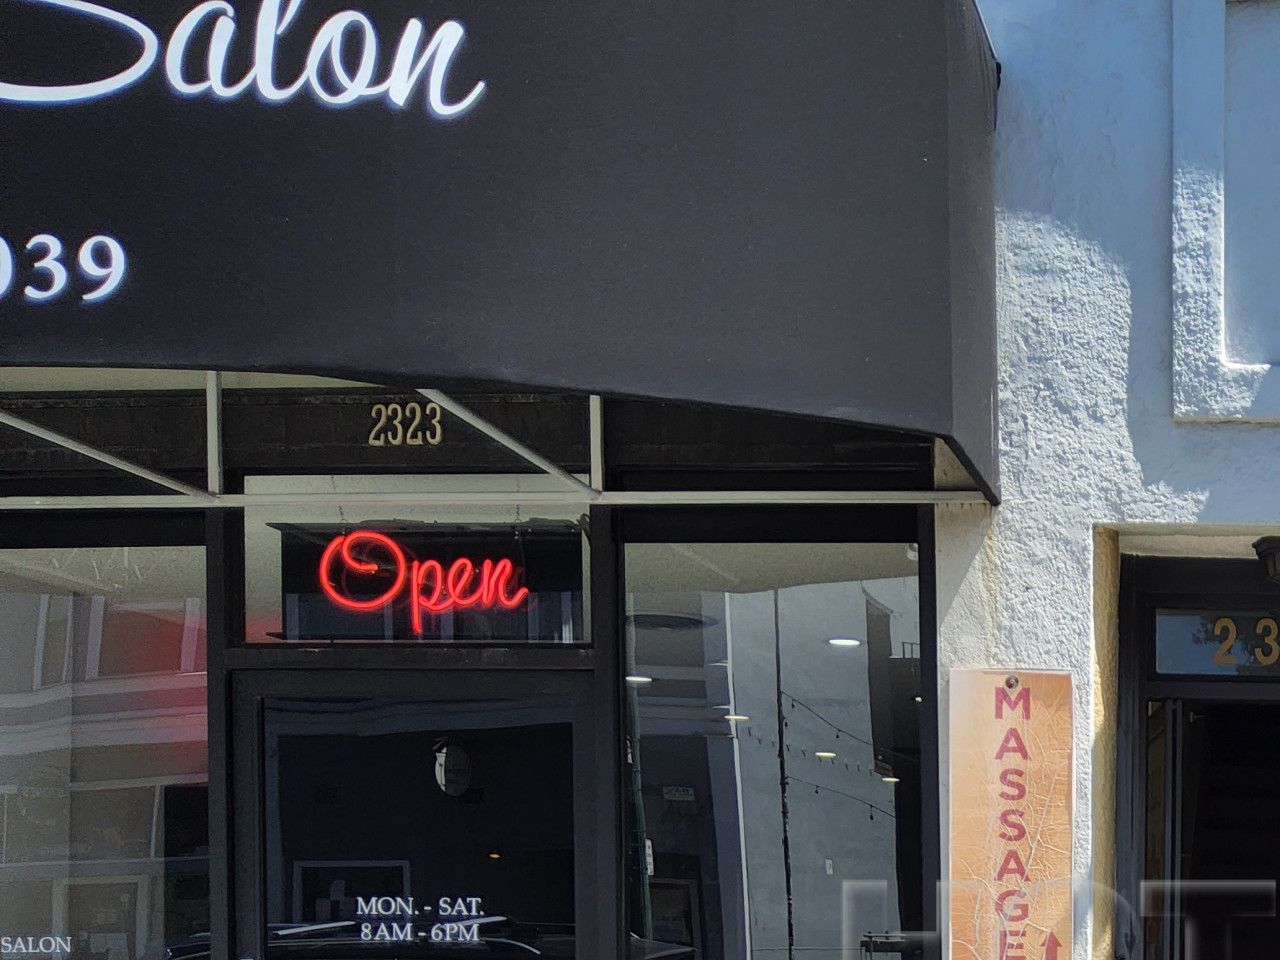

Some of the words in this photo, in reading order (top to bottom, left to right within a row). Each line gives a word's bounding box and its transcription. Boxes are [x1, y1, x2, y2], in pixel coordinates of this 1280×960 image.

[368, 402, 443, 446] 2323
[319, 530, 529, 635] Open
[356, 897, 419, 915] MON.
[439, 897, 485, 916] SAT.
[361, 922, 413, 941] 8AM
[431, 923, 480, 941] 6PM
[0, 936, 73, 953] SALON
